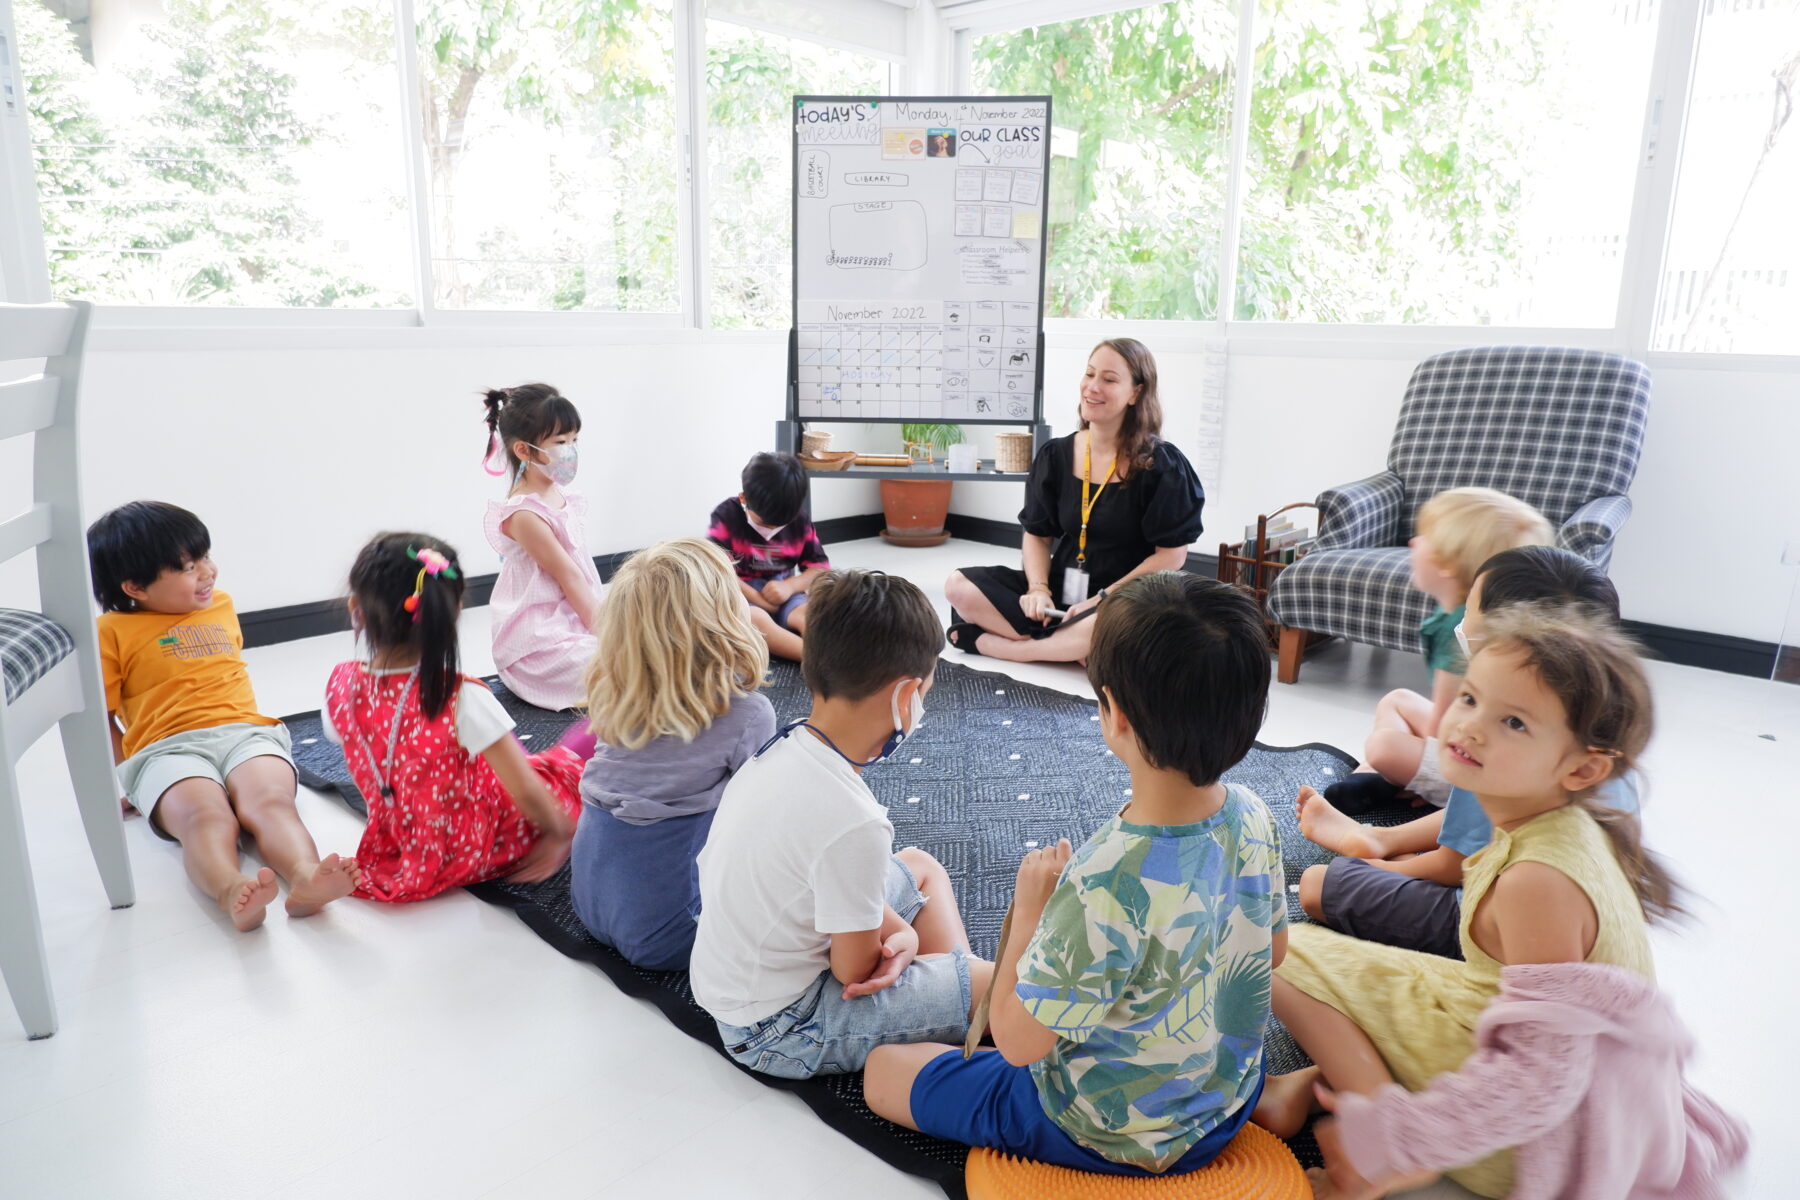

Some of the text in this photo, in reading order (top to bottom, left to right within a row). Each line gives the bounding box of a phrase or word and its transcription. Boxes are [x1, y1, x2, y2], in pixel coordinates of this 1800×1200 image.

[970, 104, 1018, 121] November
[996, 126, 1041, 142] CLASS
[854, 175, 892, 183] LIBRARY
[857, 202, 887, 210] STAGE
[827, 304, 928, 321] November 2022
